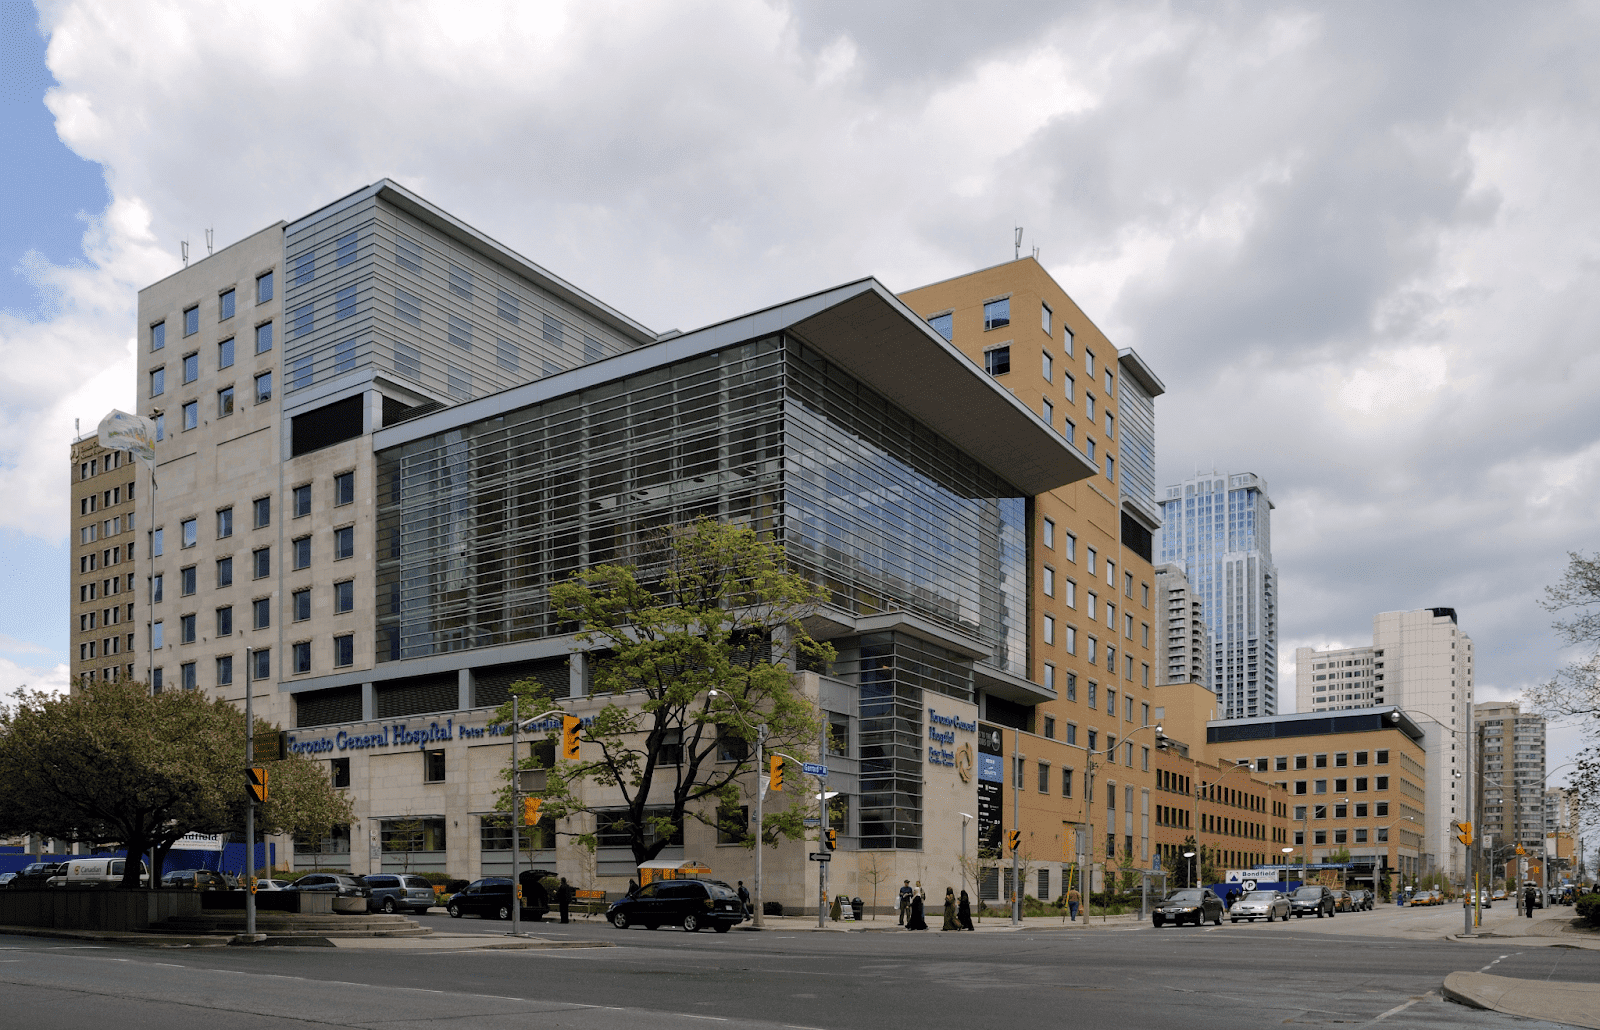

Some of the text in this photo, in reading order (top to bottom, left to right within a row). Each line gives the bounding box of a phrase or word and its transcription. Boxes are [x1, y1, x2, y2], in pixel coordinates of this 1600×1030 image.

[336, 726, 388, 749] General
[392, 719, 453, 748] Hospital
[459, 725, 485, 738] Peter
[929, 727, 955, 747] Hospital
